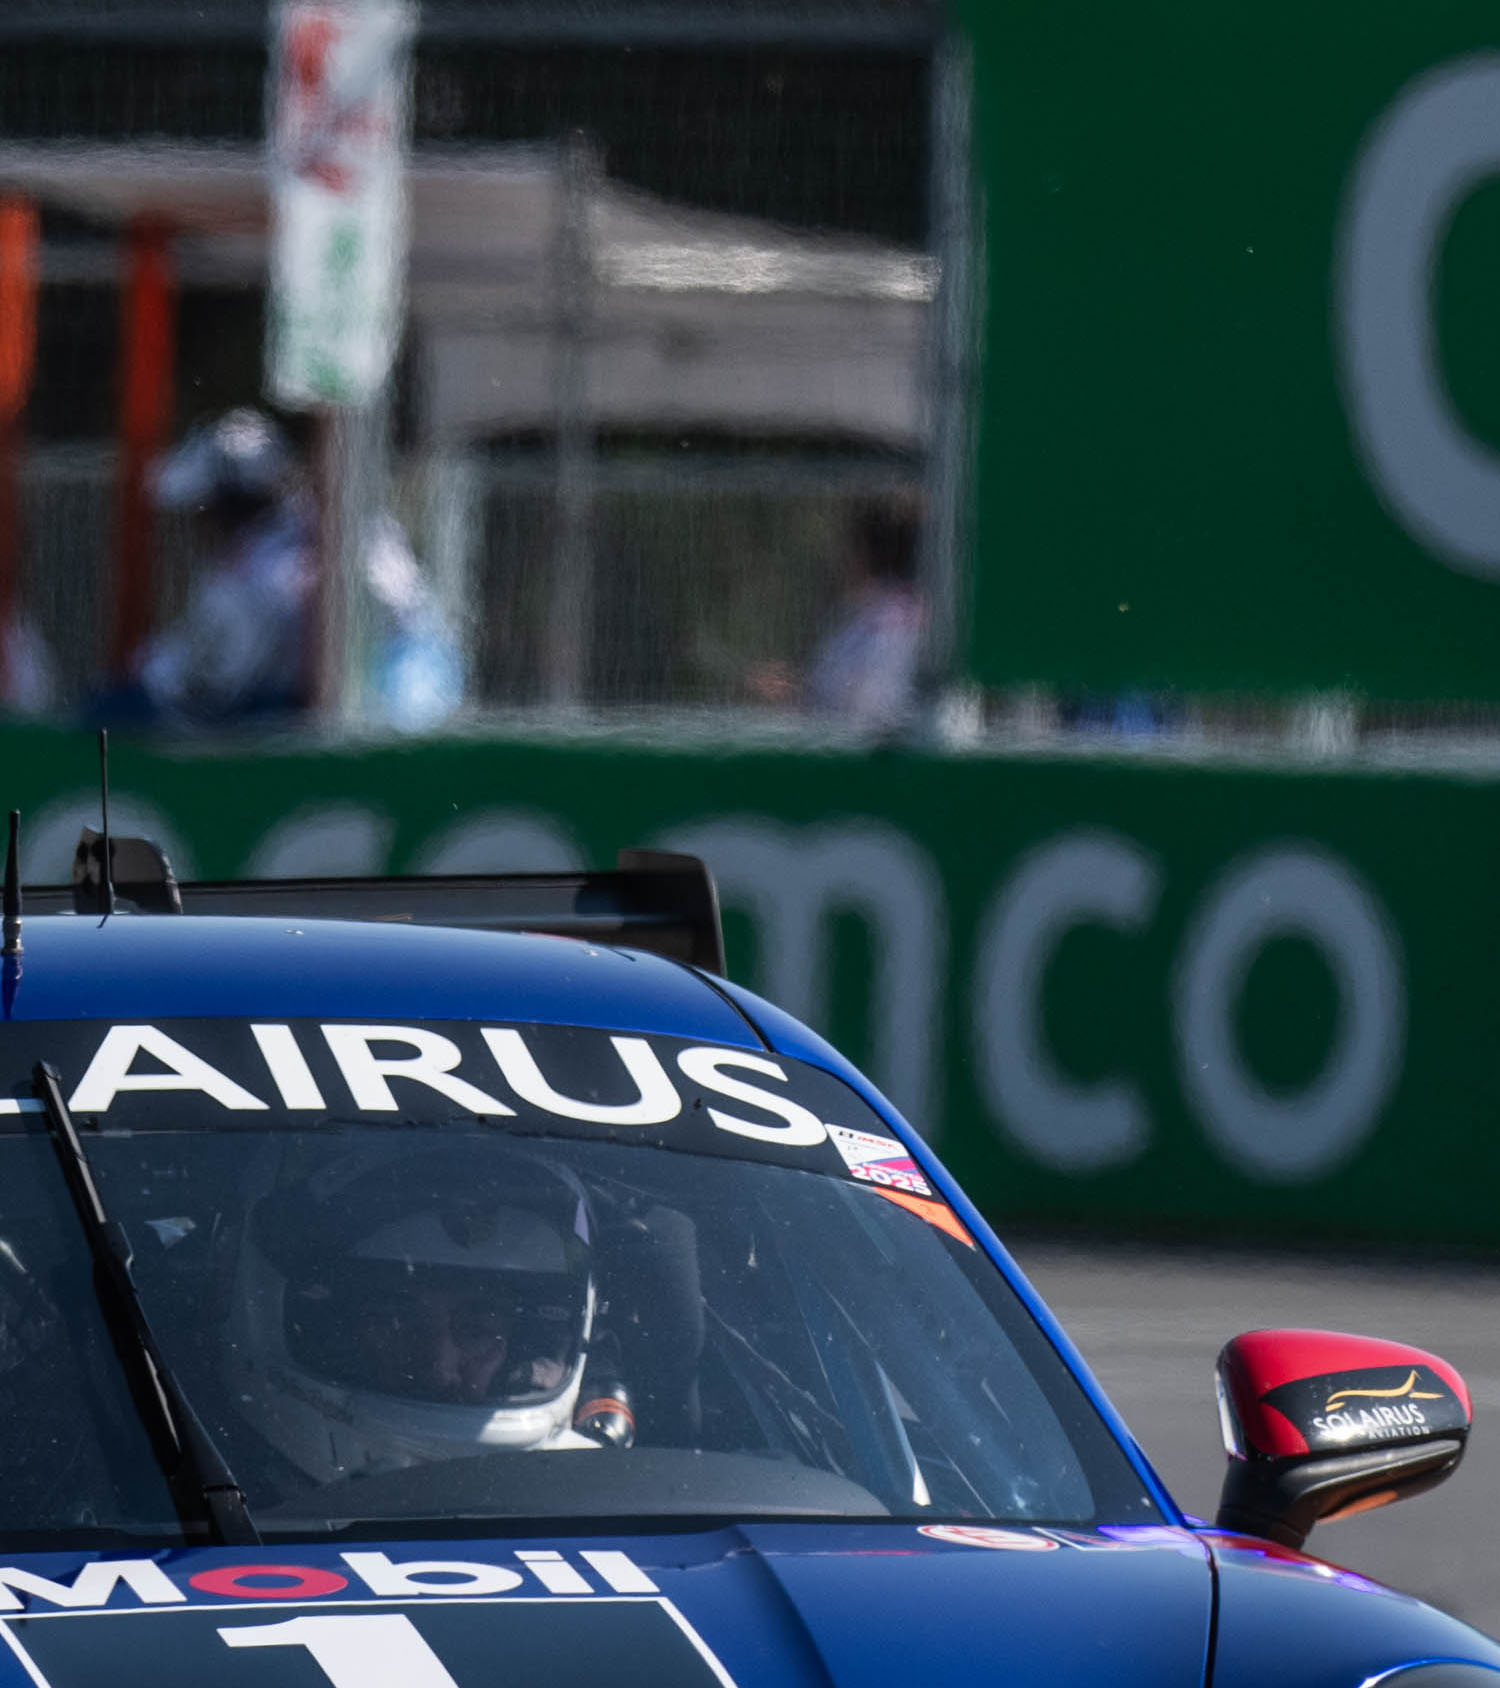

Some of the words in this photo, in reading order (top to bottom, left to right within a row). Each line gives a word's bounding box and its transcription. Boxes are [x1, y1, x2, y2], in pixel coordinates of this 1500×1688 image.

[15, 790, 1405, 1185] mco
[1312, 1402, 1427, 1438] SOLAIRUS
[1367, 1423, 1433, 1439] AVIATION
